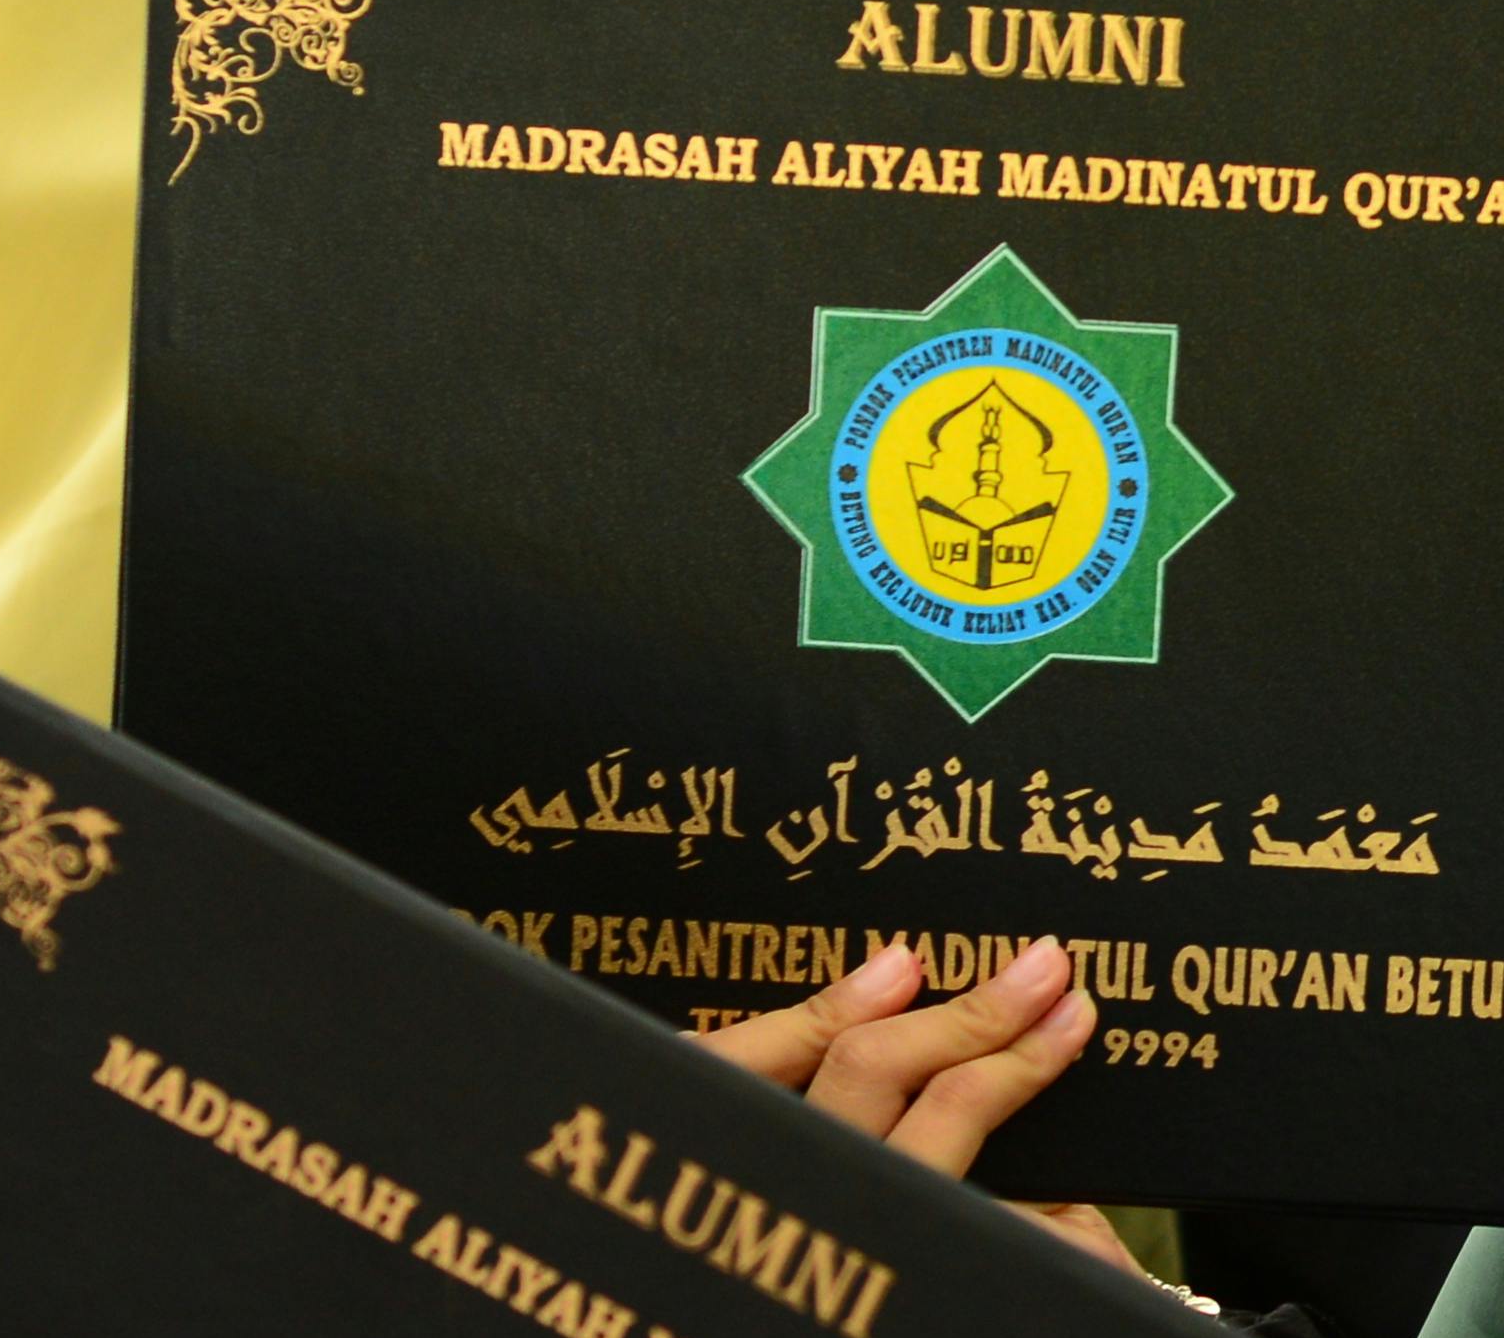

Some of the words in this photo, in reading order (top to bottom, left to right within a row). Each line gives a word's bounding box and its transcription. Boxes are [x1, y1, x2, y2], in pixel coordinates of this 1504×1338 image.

[837, 0, 1186, 89] ALUMNI
[438, 121, 761, 185] MADRASAH
[770, 139, 984, 197] ALIYAH
[996, 150, 1330, 217] MADINATUL
[843, 382, 895, 450] PONDOK
[892, 335, 993, 387] PESANTREN
[1005, 337, 1101, 401] MADINATUL
[1097, 400, 1139, 464] QUR'AN
[839, 491, 878, 559] BETUNG
[1034, 592, 1078, 623] KAB.
[1076, 549, 1117, 594] OGAN
[1106, 507, 1136, 545] ILIR
[570, 914, 847, 986] PESANTREN
[1171, 945, 1369, 1015] QUR'AN
[1104, 1028, 1219, 1069] 9994
[94, 1037, 419, 1241] MADRASAH
